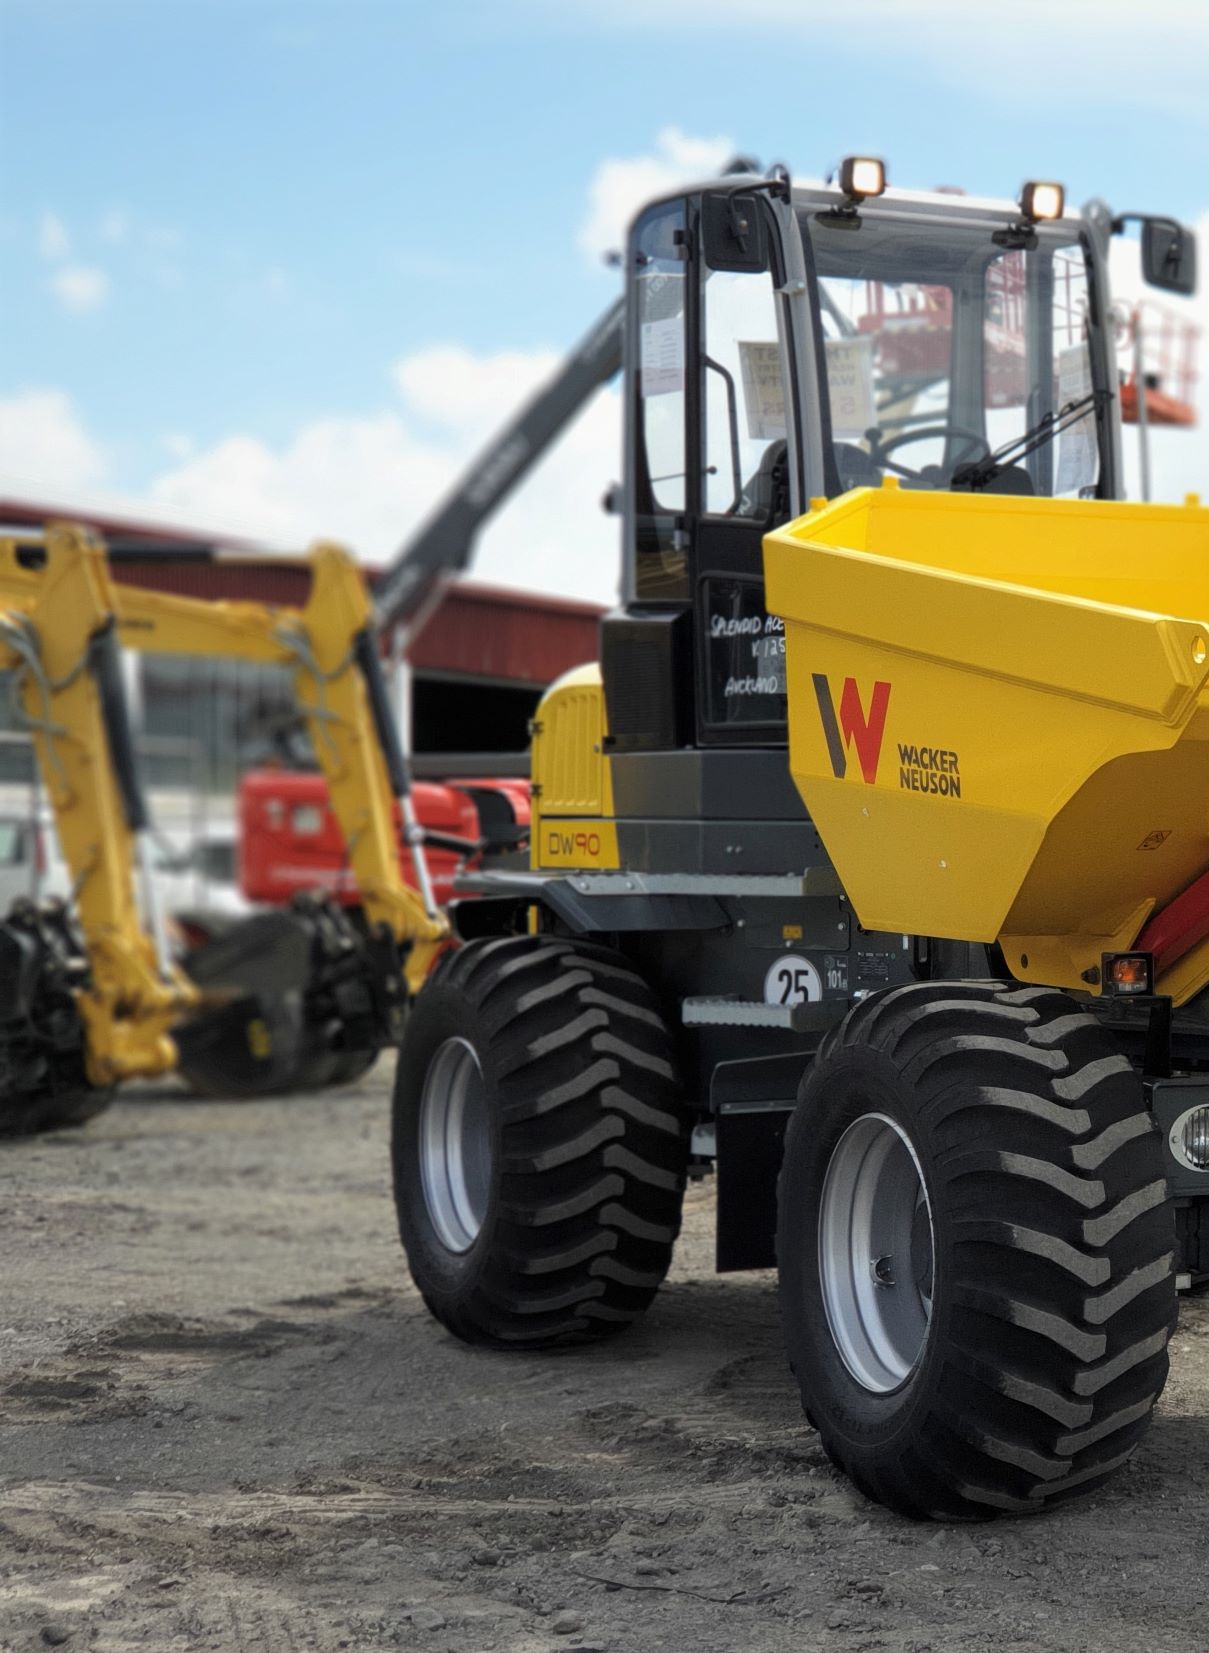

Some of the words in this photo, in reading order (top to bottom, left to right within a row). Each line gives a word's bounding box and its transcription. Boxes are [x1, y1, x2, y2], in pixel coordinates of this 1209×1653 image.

[711, 614, 762, 637] SPLENDID
[897, 743, 960, 775] WACKER
[899, 766, 961, 799] NEUSON
[549, 832, 601, 857] DW90
[777, 968, 810, 1005] 25
